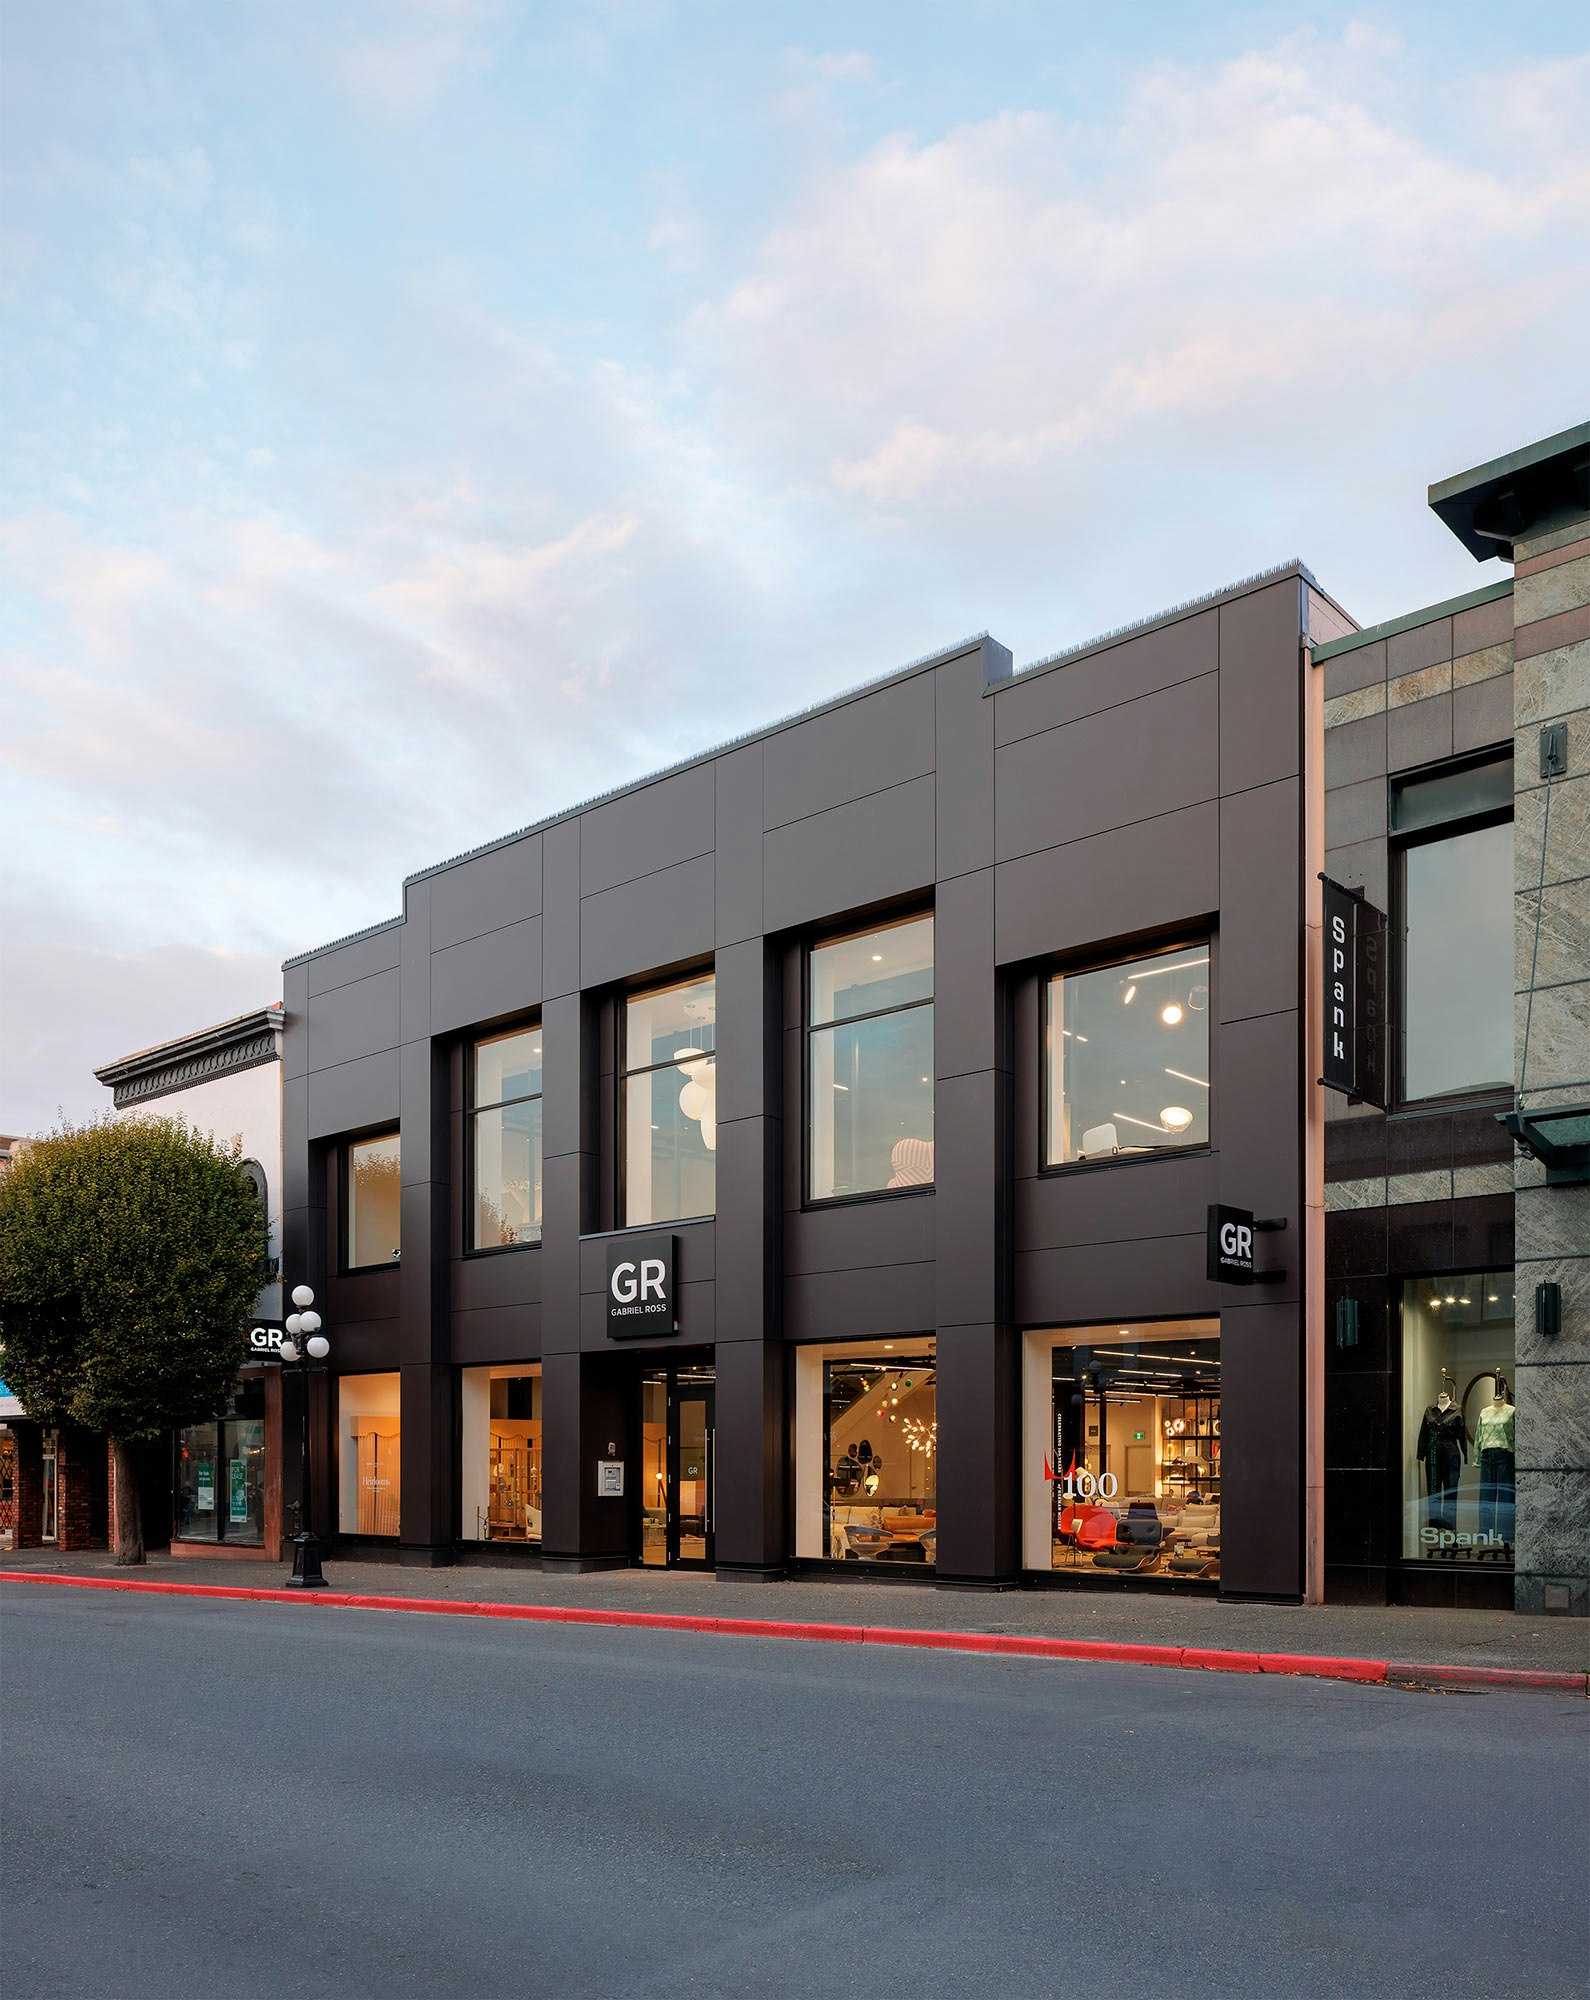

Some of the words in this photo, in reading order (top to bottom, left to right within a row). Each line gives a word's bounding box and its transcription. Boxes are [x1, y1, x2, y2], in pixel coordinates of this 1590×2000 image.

[1332, 915, 1345, 1060] Spank
[1220, 1222, 1252, 1258] GR
[1220, 1257, 1240, 1267] GABRIEL
[1240, 1260, 1252, 1269] ROSS
[611, 1259, 666, 1303] GR
[611, 1306, 643, 1317] GABRIEL
[645, 1303, 666, 1314] ROSS
[250, 1327, 282, 1347] GR
[687, 1466, 698, 1475] GR
[1063, 1472, 1118, 1498] 100
[1420, 1527, 1504, 1548] Spank
